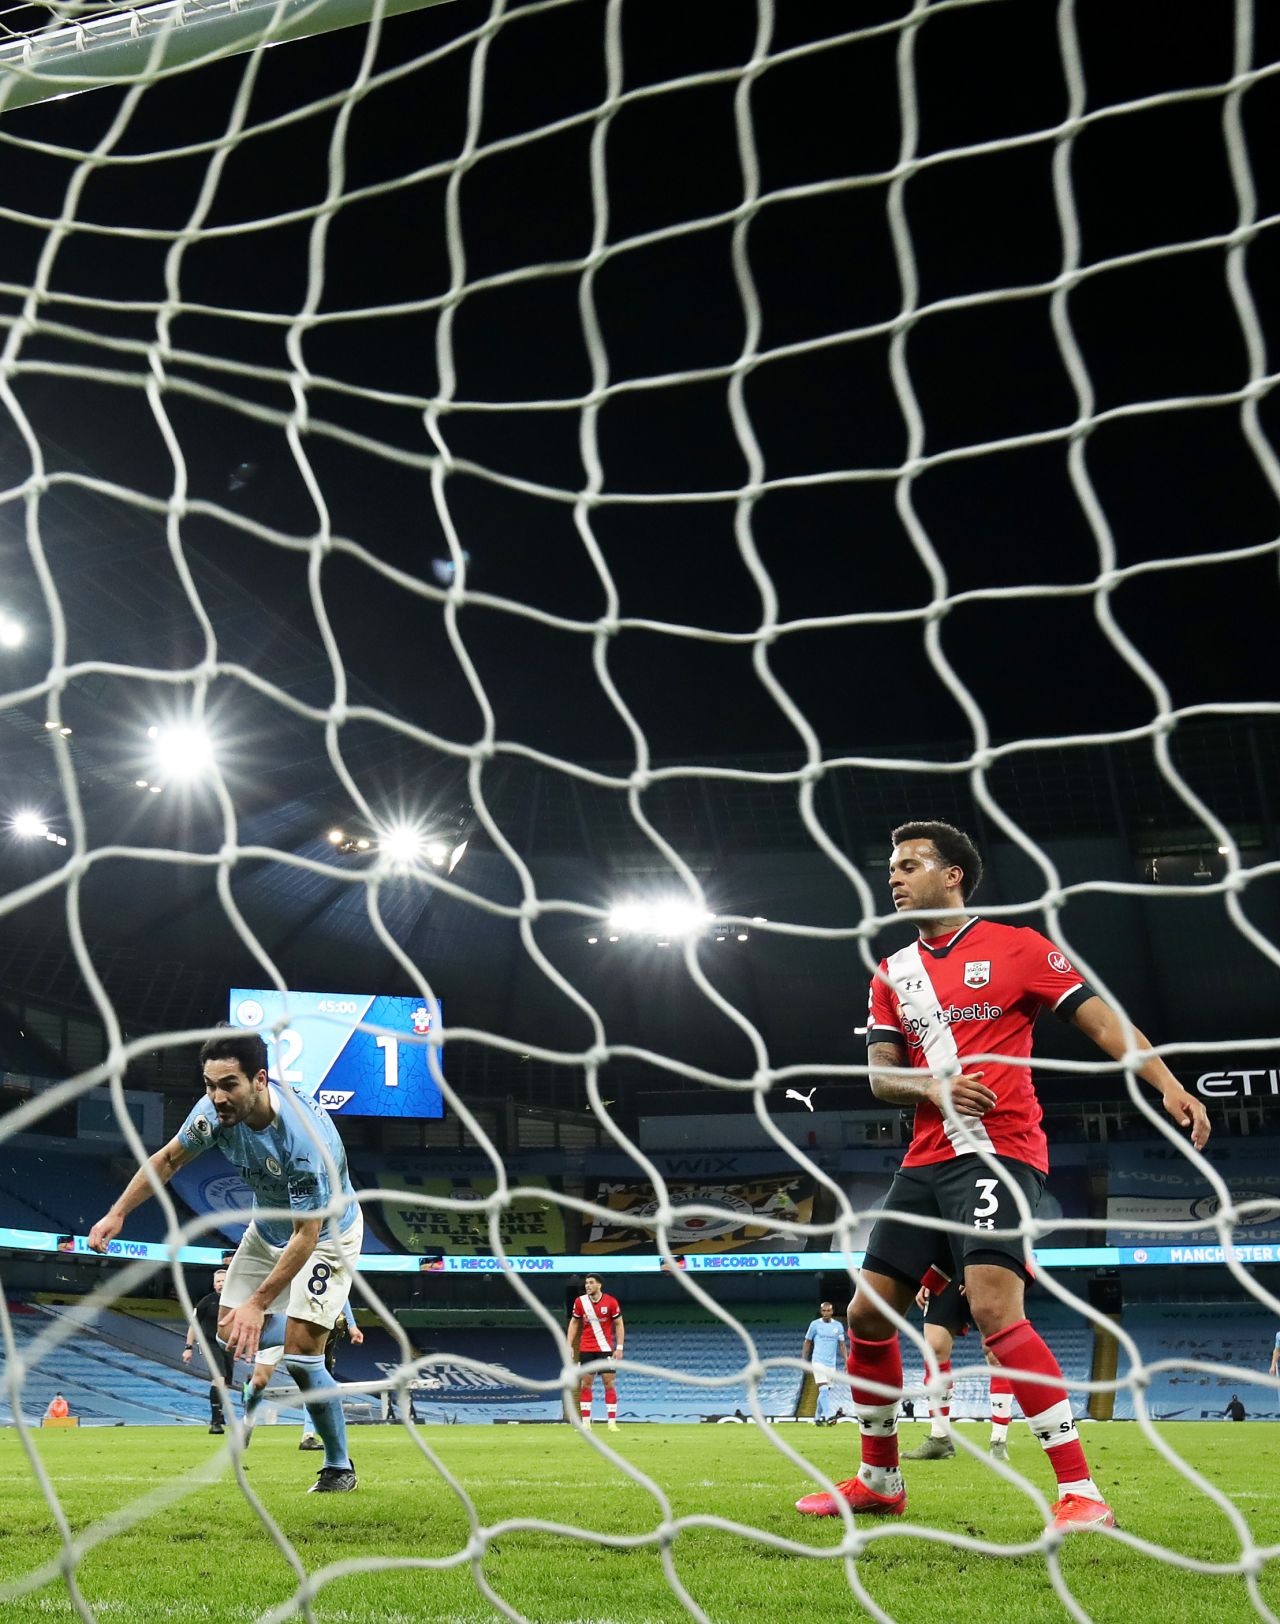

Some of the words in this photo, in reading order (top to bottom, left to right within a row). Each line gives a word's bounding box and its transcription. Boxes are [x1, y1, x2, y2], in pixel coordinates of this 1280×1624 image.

[317, 1000, 356, 1014] 45:00
[901, 1003, 1002, 1036] Spotsbet.io
[267, 1029, 304, 1083] 2
[376, 1034, 399, 1086] 1
[321, 1095, 345, 1106] SAP
[1195, 1175, 1280, 1186] POUD
[974, 1178, 999, 1217] 3
[398, 1211, 449, 1224] WE
[123, 1241, 148, 1257] YOUR
[1170, 1247, 1272, 1263] MANCHSTER
[517, 1259, 554, 1270] YOUR
[704, 1257, 758, 1268] RECORD
[761, 1256, 800, 1266] YOUR
[308, 1263, 330, 1295] 8
